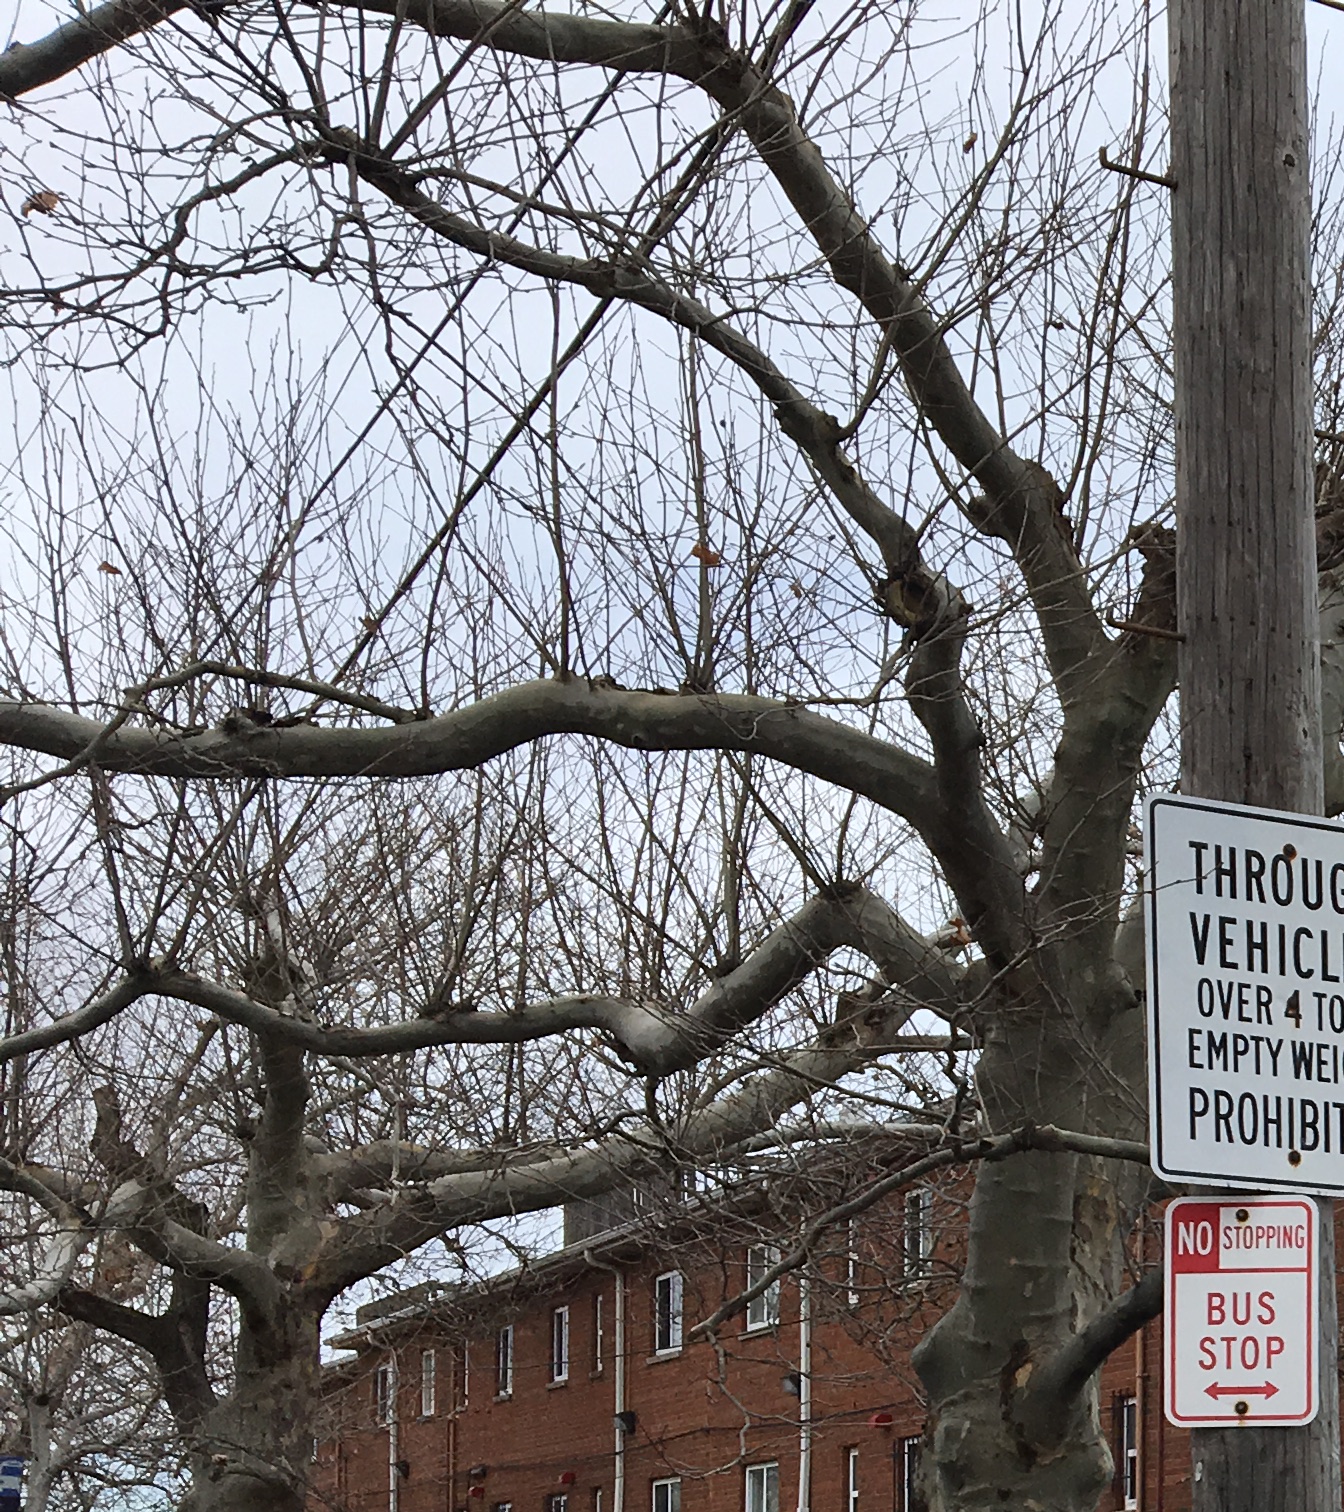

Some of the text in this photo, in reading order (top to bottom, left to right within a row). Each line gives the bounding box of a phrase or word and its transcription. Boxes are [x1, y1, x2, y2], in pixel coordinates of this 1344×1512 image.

[1197, 977, 1273, 1026] OVER
[1284, 989, 1303, 1029] 4
[1188, 1028, 1284, 1077] EMPTY
[1178, 1221, 1305, 1256] NO STOPPING
[1207, 1291, 1276, 1326] BUS
[1198, 1336, 1285, 1371] STOP
